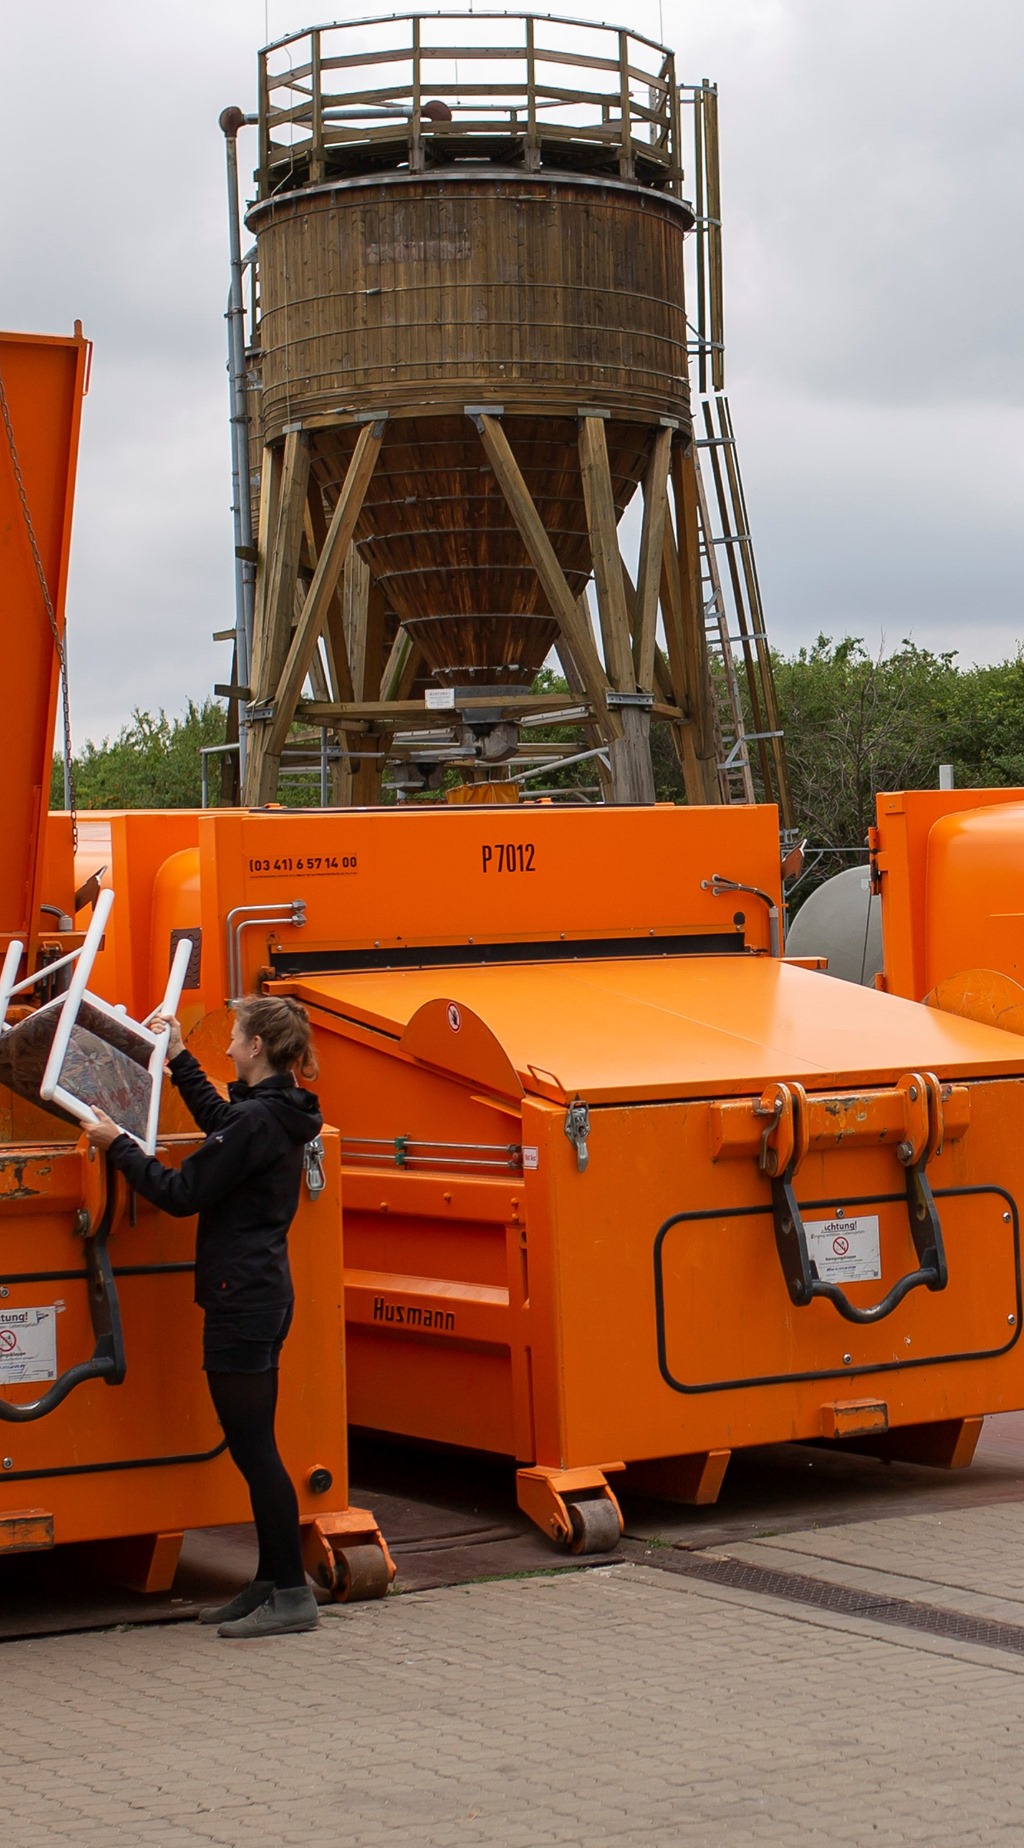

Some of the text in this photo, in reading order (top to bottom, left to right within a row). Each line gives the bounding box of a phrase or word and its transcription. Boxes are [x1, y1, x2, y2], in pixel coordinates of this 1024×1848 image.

[249, 857, 357, 872] (03 41) 6 57 14 00
[824, 1221, 857, 1231] chtung!
[373, 1297, 455, 1331] Husmann
